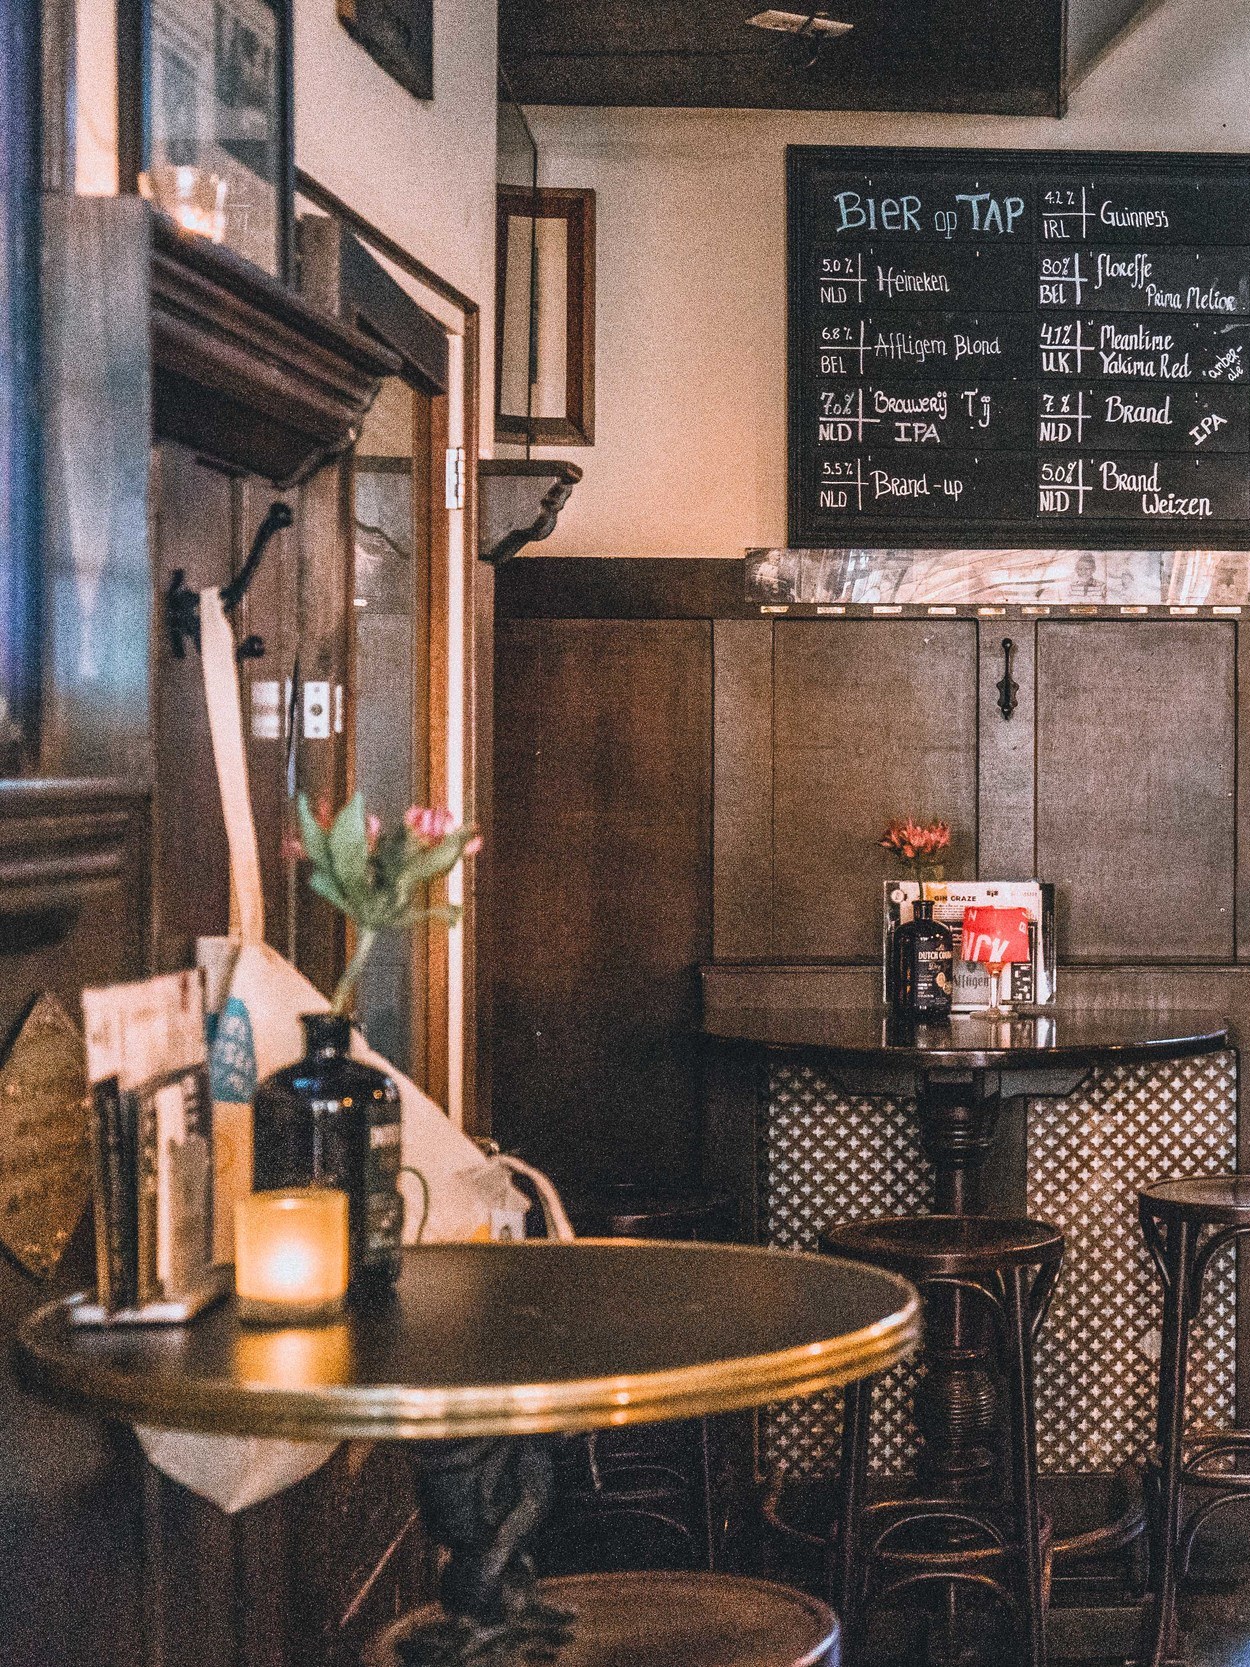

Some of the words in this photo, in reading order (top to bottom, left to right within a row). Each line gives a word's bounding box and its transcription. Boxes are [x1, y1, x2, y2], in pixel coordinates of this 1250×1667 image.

[955, 192, 1024, 233] TAP
[1100, 200, 1169, 228] Guinness
[1043, 220, 1070, 239] IRL
[877, 265, 950, 298] Heineken
[820, 286, 847, 304] NLD
[1040, 284, 1066, 305] BEL
[1146, 283, 1182, 309] Prima
[874, 332, 948, 363] Affligem
[954, 334, 1001, 361] Blond
[1100, 324, 1175, 351] Meantime
[820, 354, 847, 374] BEL
[1099, 351, 1157, 375] Yakima
[1160, 353, 1192, 379] Red
[1105, 395, 1173, 425] Brand
[819, 424, 852, 442] NLD
[894, 423, 941, 443] IPA
[1039, 422, 1072, 443] NLD
[1189, 414, 1228, 446] IPA
[1099, 461, 1161, 492] Brand
[820, 490, 847, 508] NLD
[1039, 491, 1070, 512] NLD
[1142, 493, 1213, 516] Weizen
[918, 951, 939, 960] DUTCH
